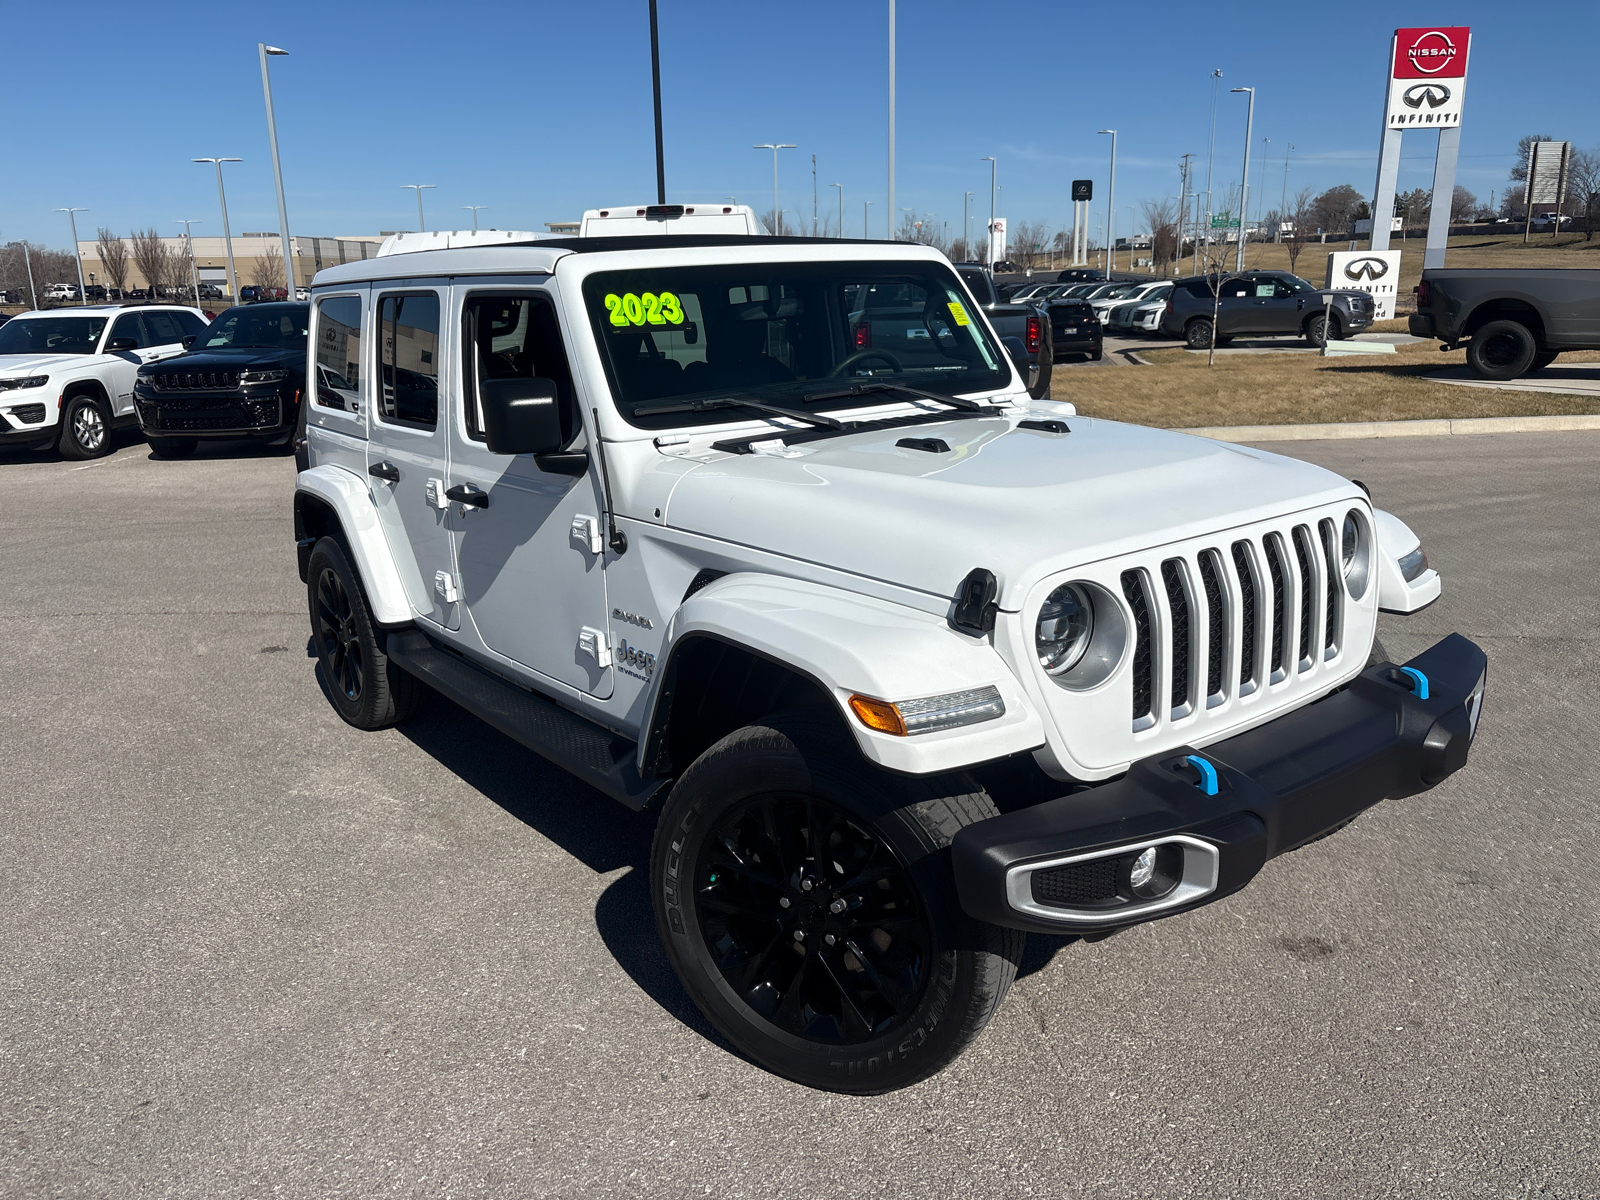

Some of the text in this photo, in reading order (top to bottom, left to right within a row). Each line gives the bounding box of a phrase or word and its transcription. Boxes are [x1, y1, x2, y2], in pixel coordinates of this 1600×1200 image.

[1408, 48, 1456, 56] NISSAN
[1390, 113, 1458, 124] INFINITI
[604, 292, 684, 327] 2023
[616, 639, 656, 675] Jeep
